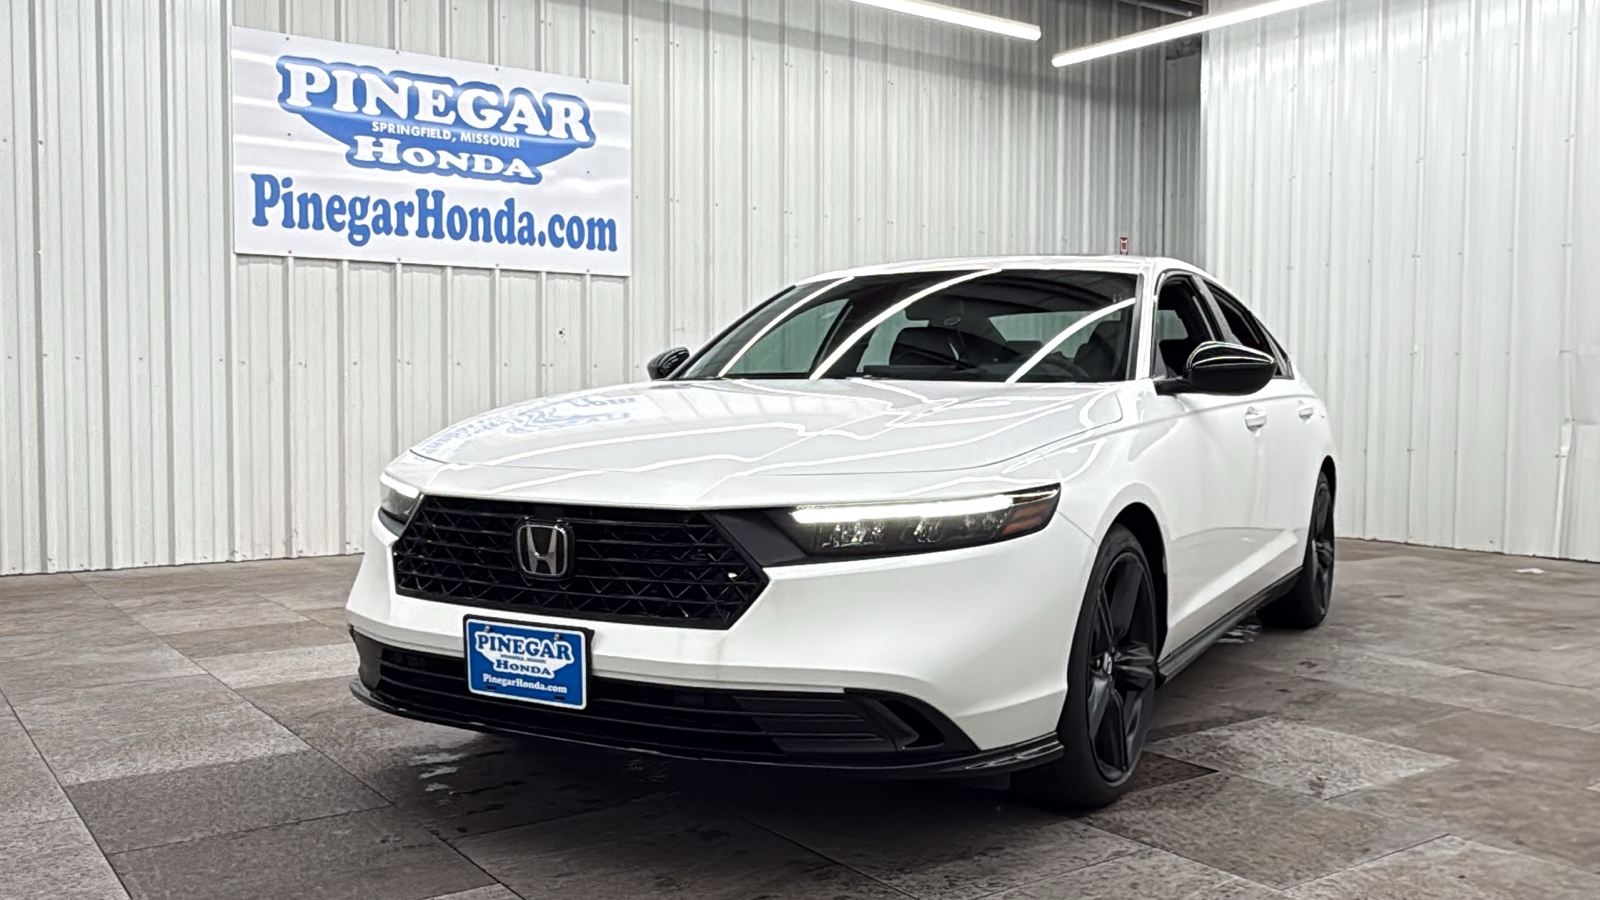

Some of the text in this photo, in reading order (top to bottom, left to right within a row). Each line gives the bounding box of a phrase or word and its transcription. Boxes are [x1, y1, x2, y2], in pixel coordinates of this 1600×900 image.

[281, 62, 590, 142] PINEGAR
[371, 121, 521, 149] SPRINGFIELD, MISSOURI
[353, 135, 537, 178] HONDA
[251, 173, 618, 252] PinegarHonda.com
[477, 634, 573, 661] PINEGAR
[495, 659, 553, 676] HONDA
[482, 673, 568, 694] PinegarHonda.com
